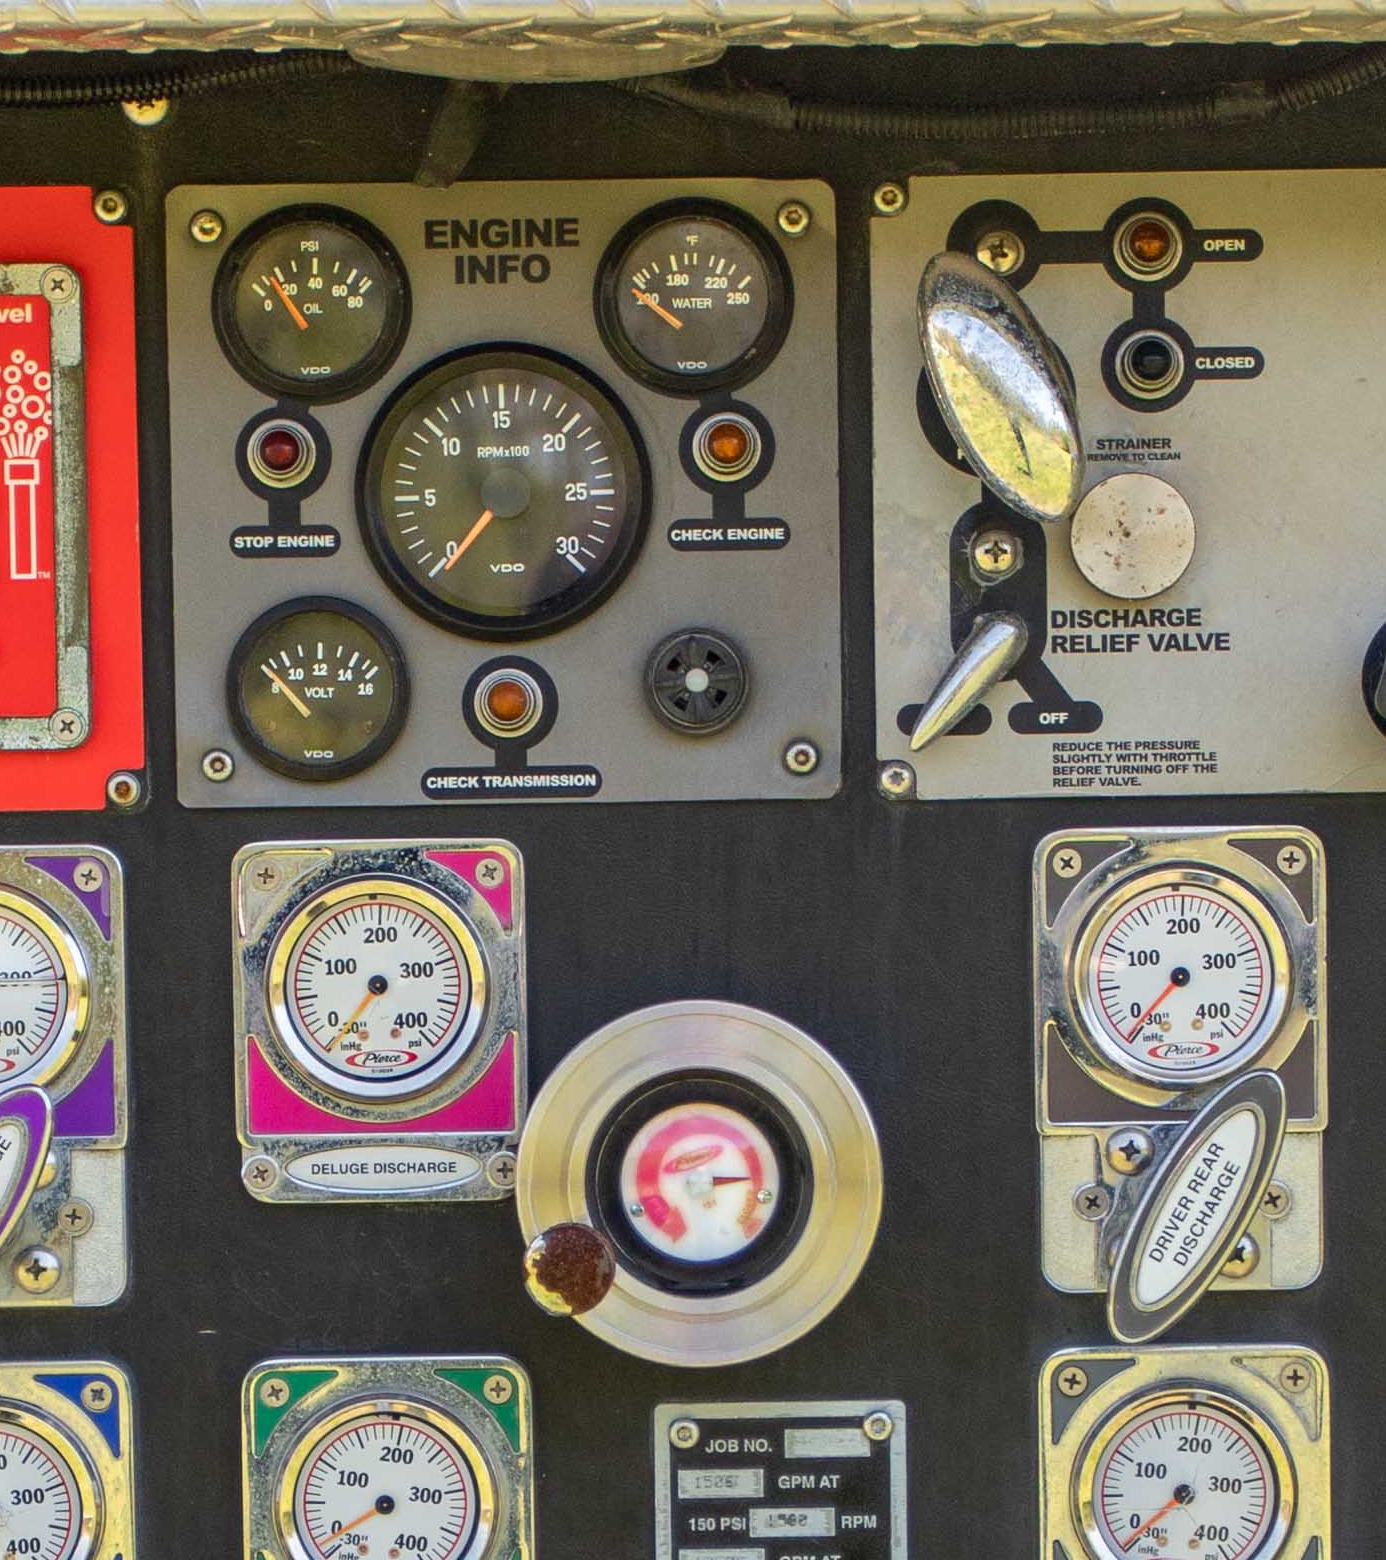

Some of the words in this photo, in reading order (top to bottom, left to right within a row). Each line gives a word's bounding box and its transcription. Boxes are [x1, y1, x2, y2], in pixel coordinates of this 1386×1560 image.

[424, 219, 579, 249] ENGINE
[1204, 240, 1245, 251] OPEN
[454, 254, 550, 284] INFO
[671, 297, 711, 309] WATER
[1195, 357, 1255, 369] CLOSED
[492, 411, 510, 429] 15
[477, 445, 529, 458] RPMx100
[1097, 438, 1172, 450] STRAINER
[565, 483, 587, 501] 25
[234, 536, 274, 548] STOP
[278, 535, 334, 548] ENGINE
[670, 528, 721, 542] CHECK
[726, 527, 785, 541] ENGINE
[557, 537, 578, 554] 30
[490, 564, 524, 572] VDO
[1050, 609, 1202, 628] DISCHARGE
[1051, 635, 1140, 653] RELIEF
[1149, 633, 1230, 651] VALVE
[1039, 713, 1068, 724] OFF
[427, 776, 478, 789] CHECK
[483, 774, 595, 788] TRANSMISSION
[311, 1163, 370, 1175] DELUGE
[374, 1161, 456, 1174] DISCHARGE
[1150, 1194, 1193, 1263] DRIVER
[1188, 1142, 1223, 1194] REAR
[1173, 1161, 1240, 1267] DISCHARGE
[705, 1439, 738, 1453] JOB
[742, 1439, 772, 1452] NO.
[688, 1518, 716, 1531] 150
[720, 1518, 746, 1531] PSI
[841, 1515, 876, 1529] RPM
